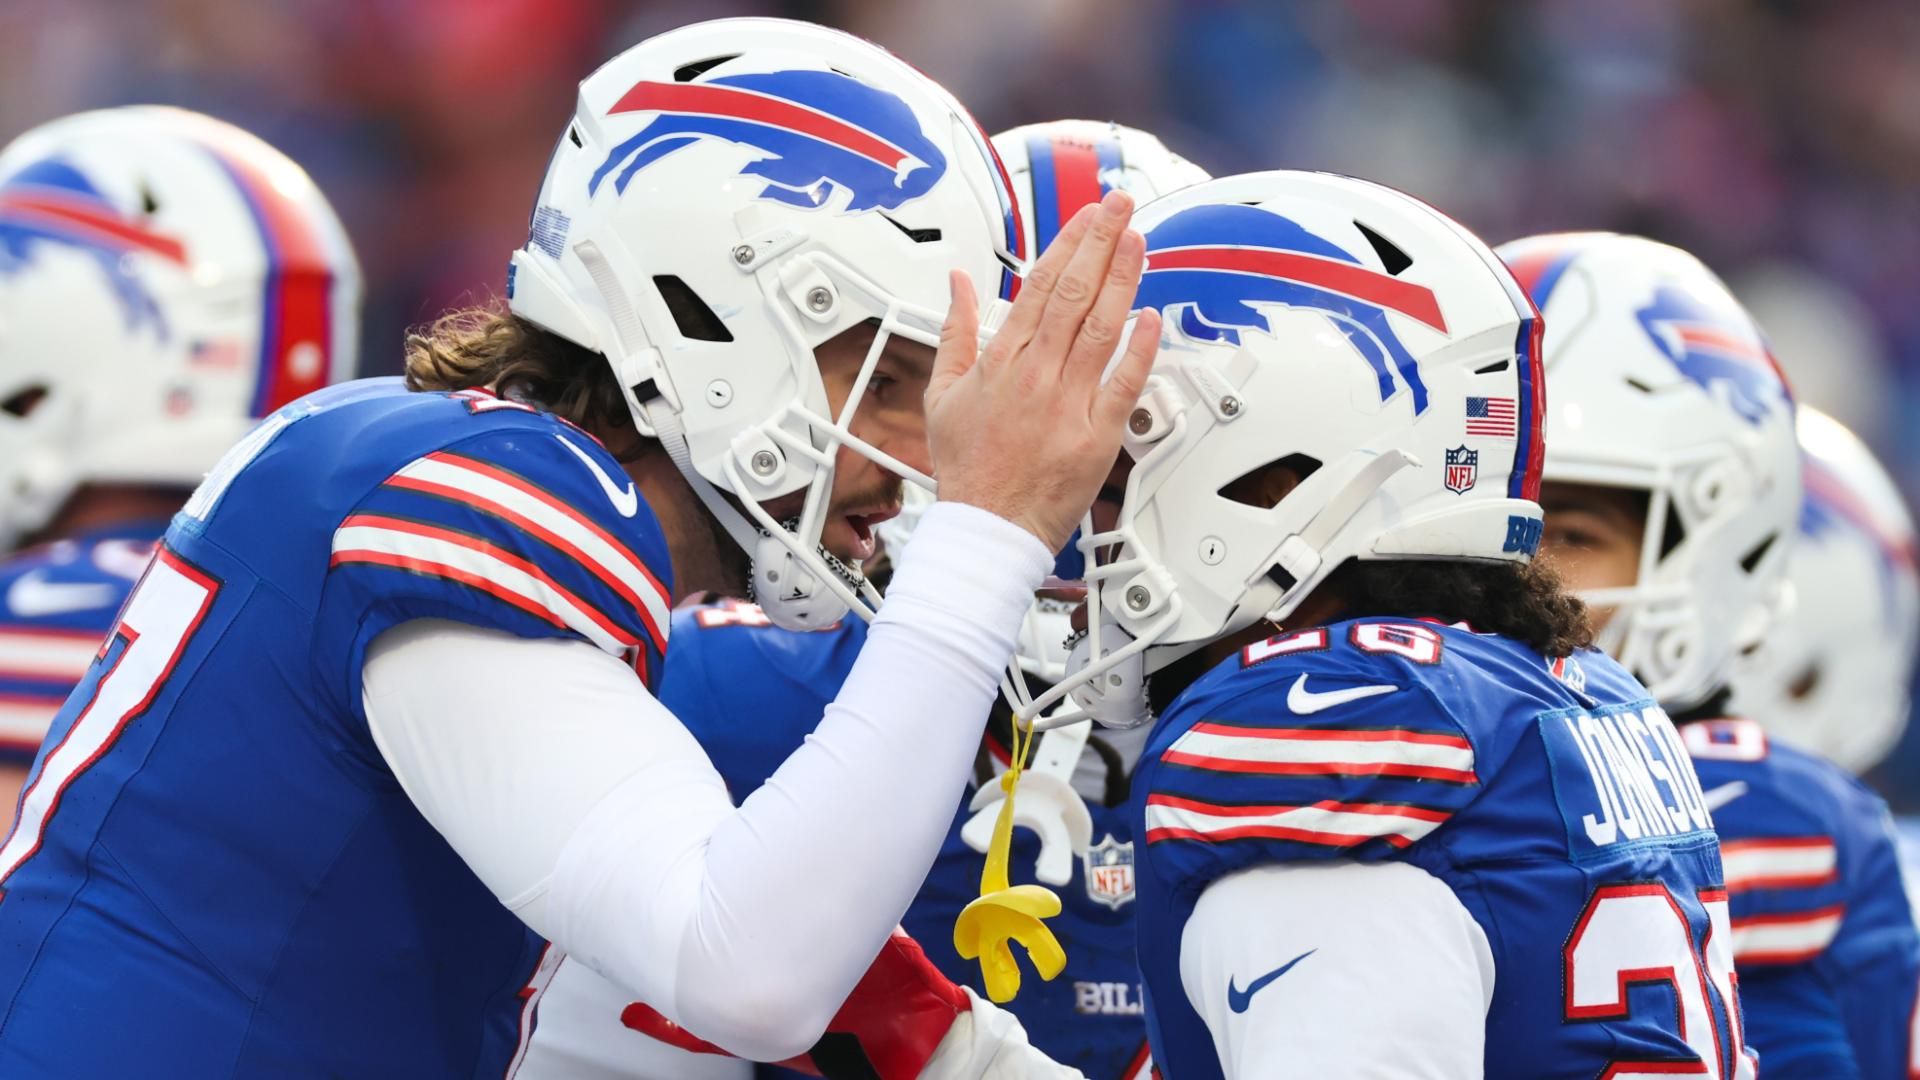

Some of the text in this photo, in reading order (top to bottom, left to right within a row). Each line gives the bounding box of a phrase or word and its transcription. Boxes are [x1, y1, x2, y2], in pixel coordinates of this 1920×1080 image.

[1447, 465, 1474, 490] NFL
[1503, 514, 1544, 556] BI
[1564, 706, 1715, 847] JOHNSO
[1094, 867, 1132, 896] NFL
[1074, 981, 1145, 1015] BIL
